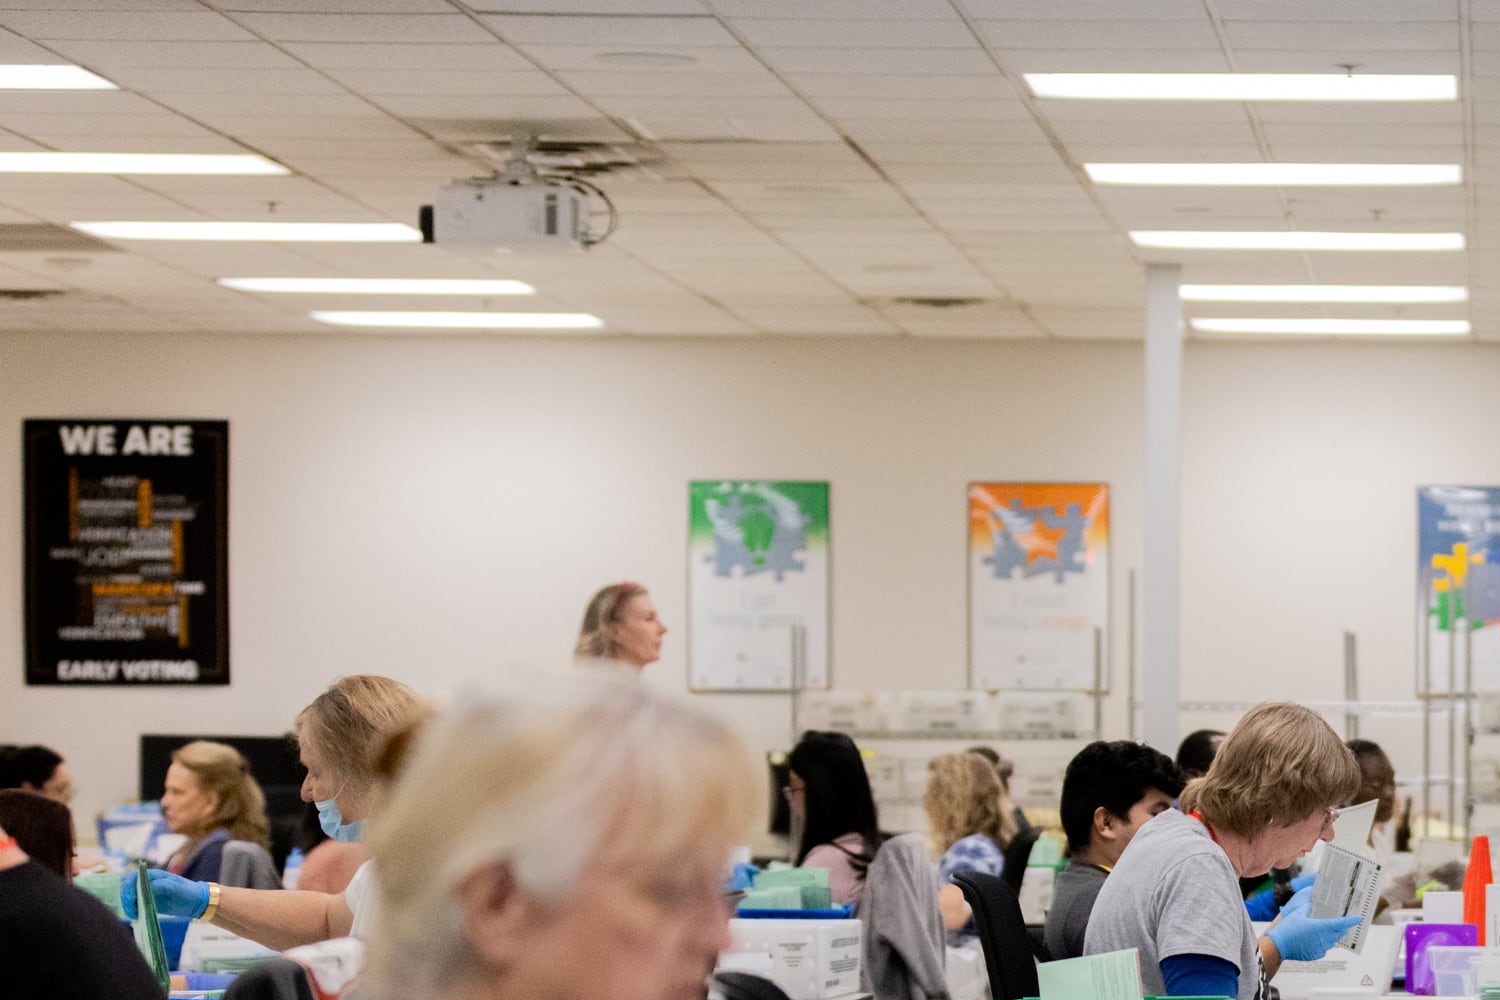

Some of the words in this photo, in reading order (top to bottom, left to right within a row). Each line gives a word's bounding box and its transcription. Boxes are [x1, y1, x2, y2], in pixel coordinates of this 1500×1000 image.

[59, 426, 117, 455] WE
[121, 425, 194, 455] ARE
[57, 660, 118, 680] EARLY
[121, 660, 199, 680] VOTING
